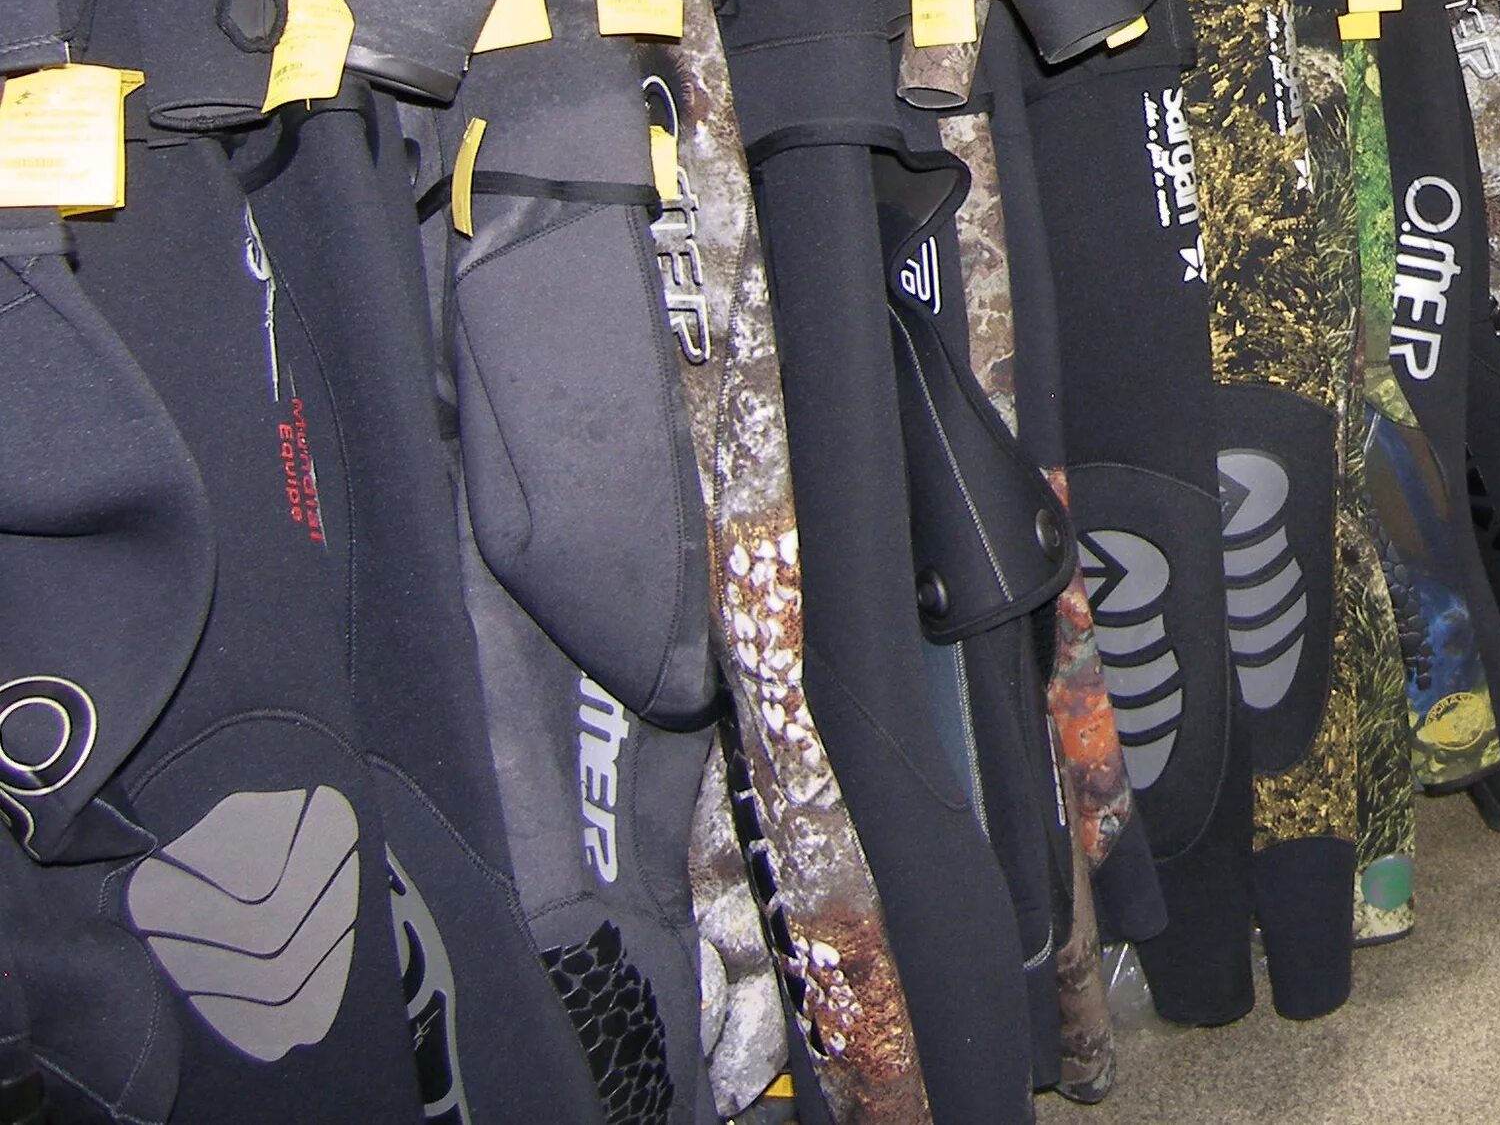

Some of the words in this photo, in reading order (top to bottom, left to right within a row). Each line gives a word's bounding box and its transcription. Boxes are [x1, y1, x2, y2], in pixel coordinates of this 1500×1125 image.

[1162, 86, 1201, 225] sargan
[278, 422, 303, 523] Equipe
[290, 397, 323, 542] Mundial
